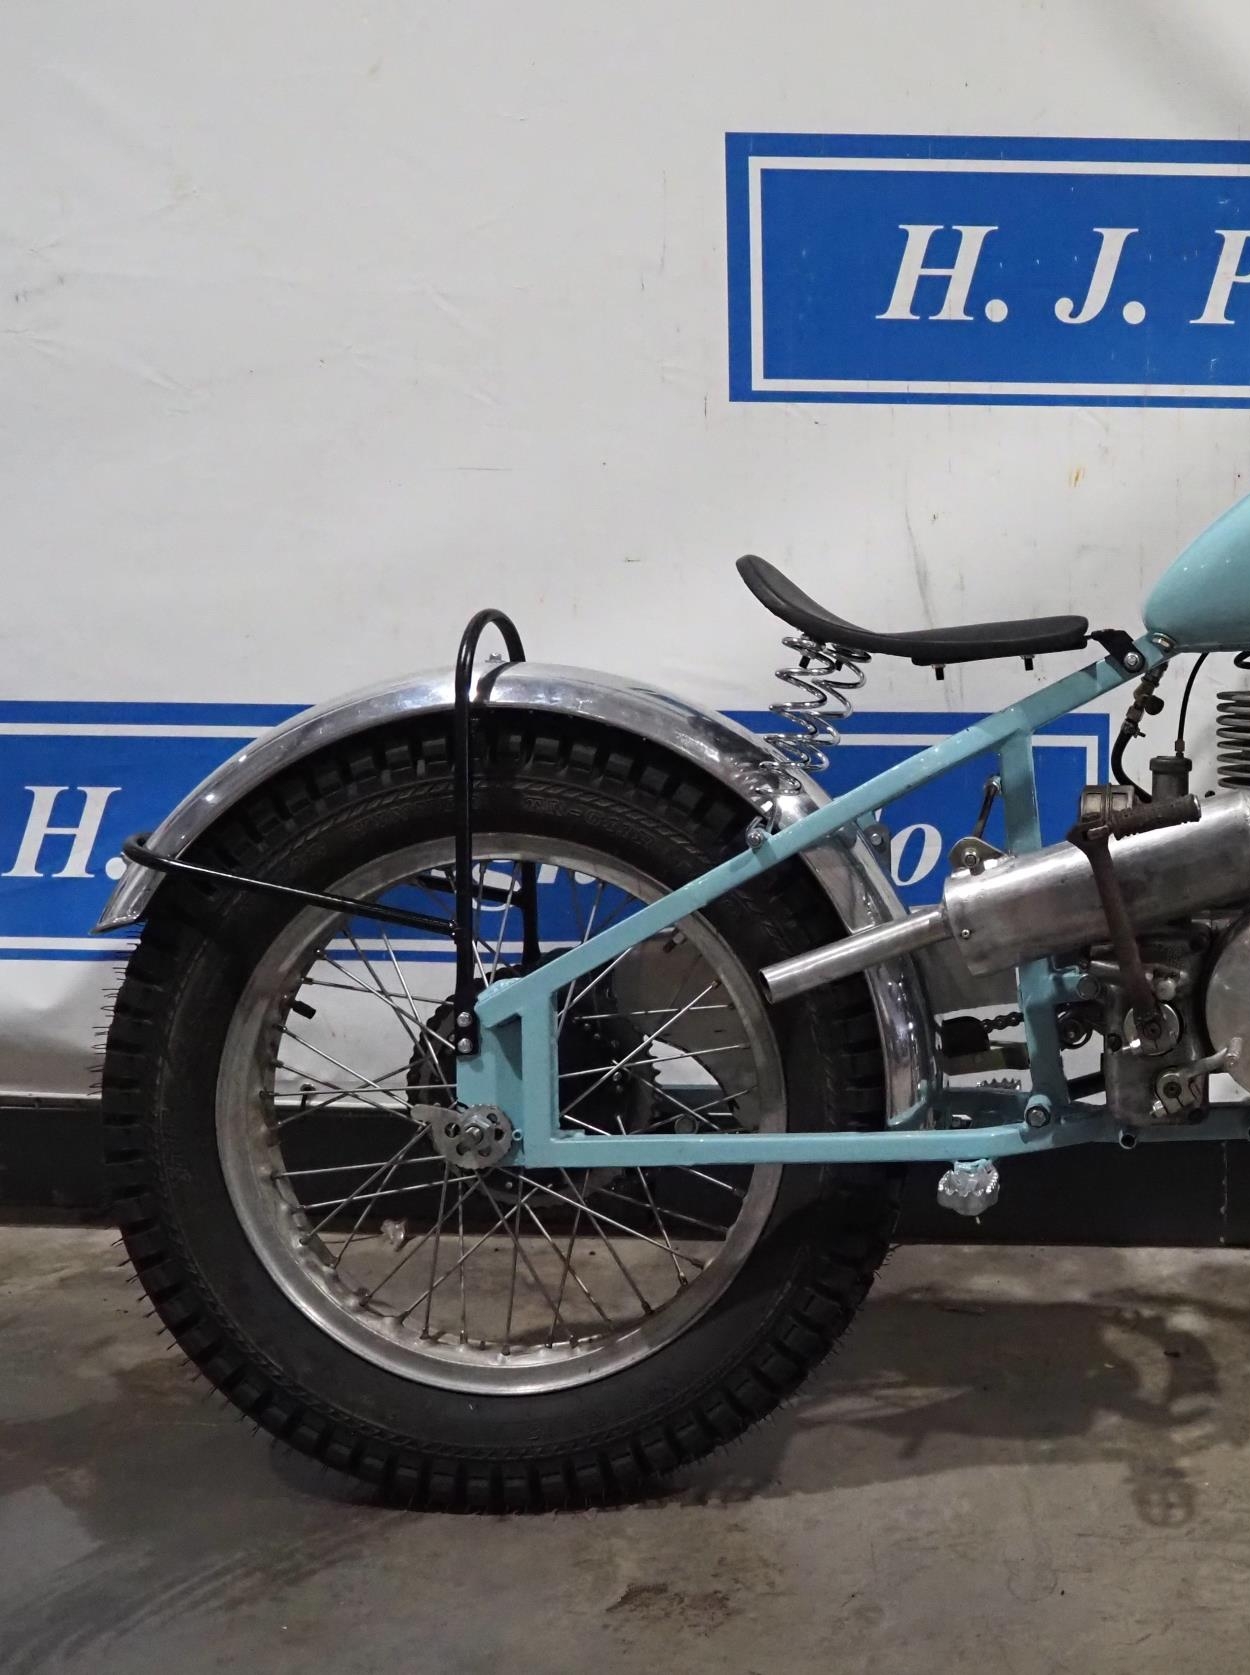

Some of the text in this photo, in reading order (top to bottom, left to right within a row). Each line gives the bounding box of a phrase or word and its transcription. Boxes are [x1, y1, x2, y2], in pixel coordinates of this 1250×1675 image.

[875, 224, 1009, 323] H.
[1054, 227, 1147, 325] J.
[1, 785, 128, 881] H.
